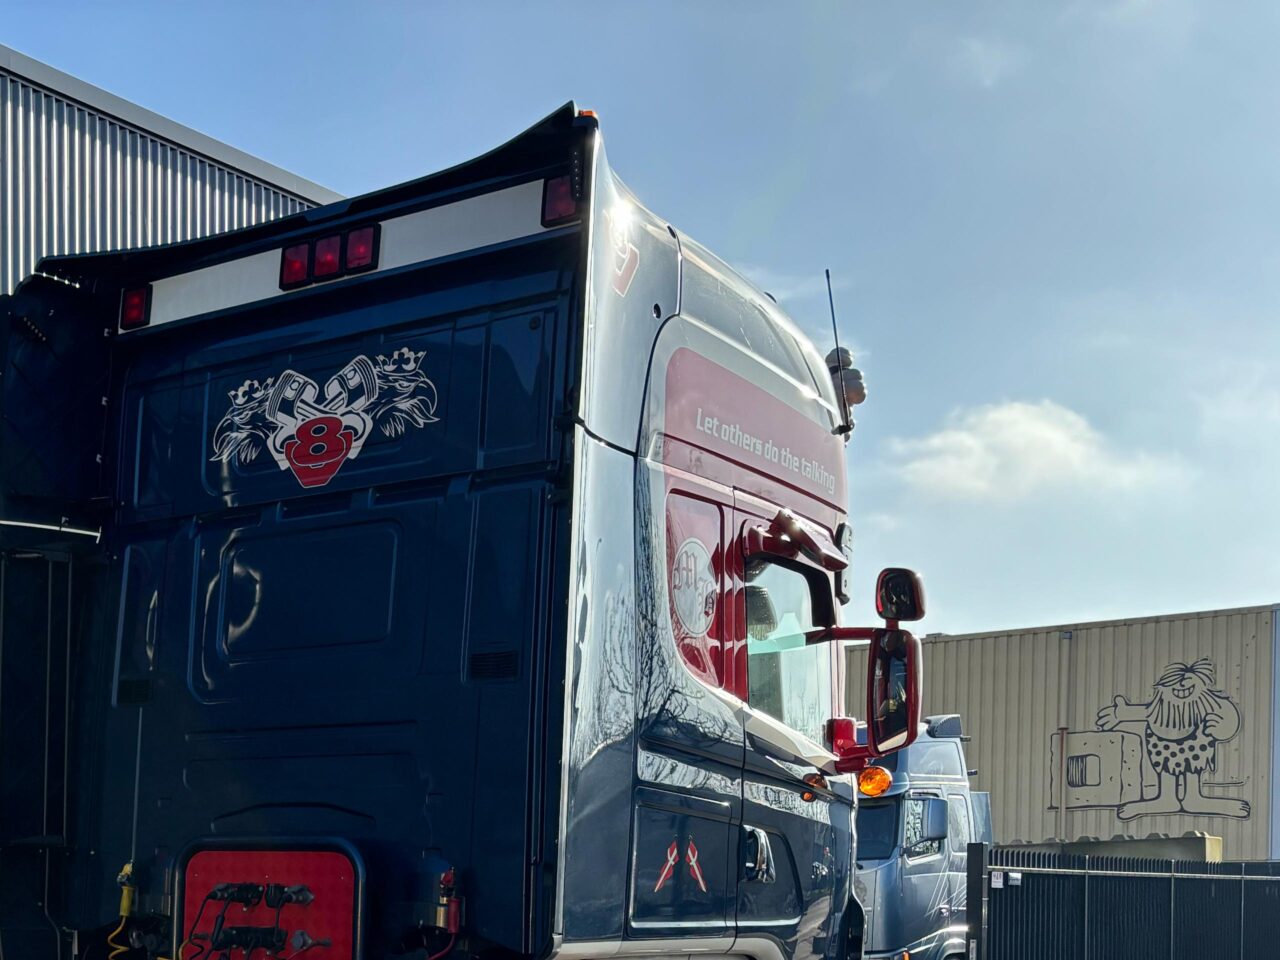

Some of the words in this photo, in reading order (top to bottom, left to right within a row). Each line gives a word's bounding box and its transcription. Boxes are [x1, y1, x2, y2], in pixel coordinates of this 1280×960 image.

[696, 407, 720, 437] Let
[721, 424, 763, 456] others
[764, 440, 779, 464] do
[780, 447, 800, 472] the
[801, 457, 836, 495] talking
